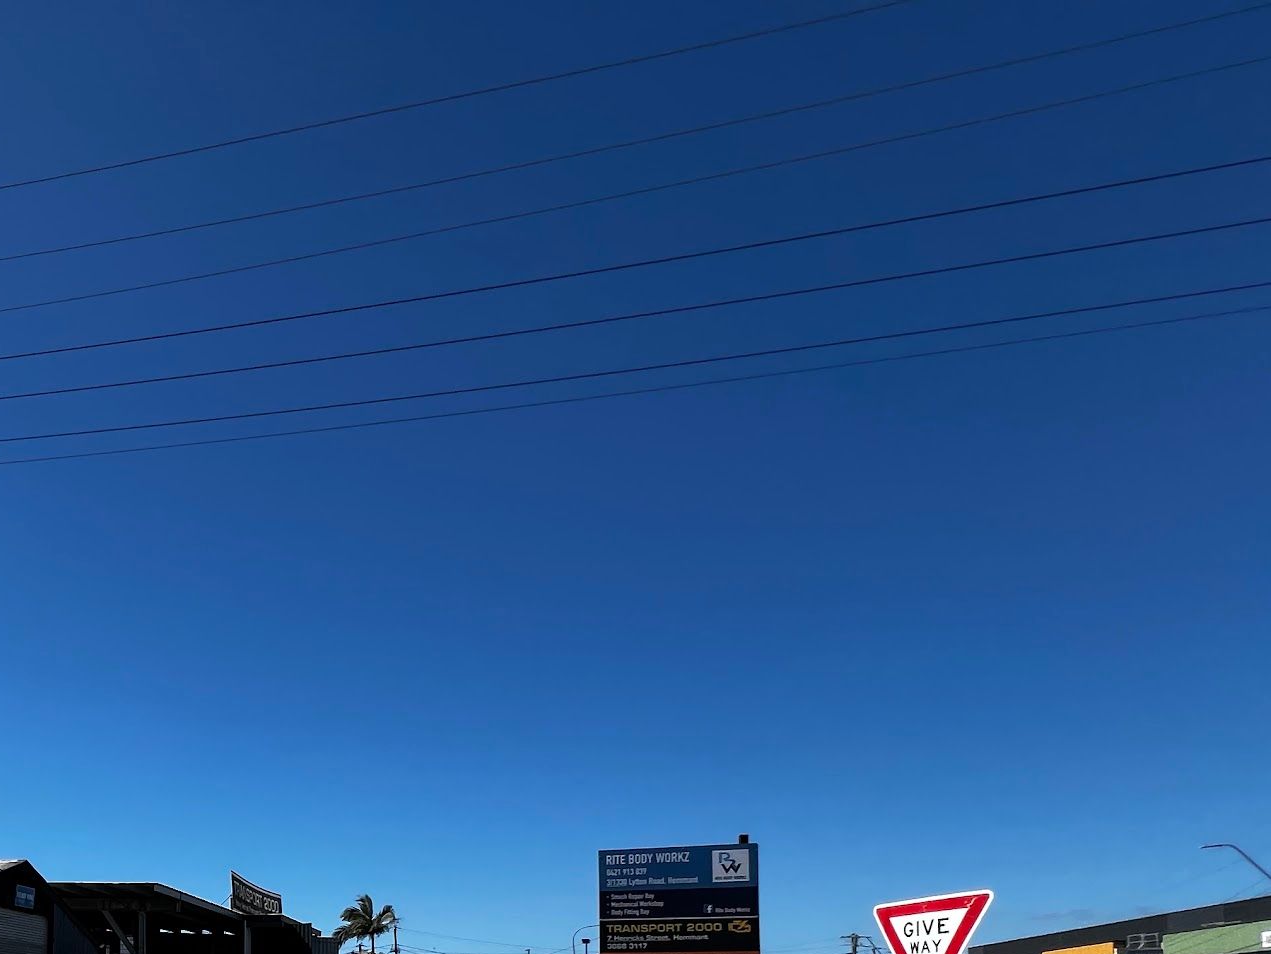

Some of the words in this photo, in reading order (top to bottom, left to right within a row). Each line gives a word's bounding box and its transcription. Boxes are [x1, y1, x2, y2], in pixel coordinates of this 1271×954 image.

[606, 854, 625, 866] RITE
[628, 853, 652, 865] BODY
[656, 851, 690, 863] WORKZ
[606, 923, 683, 933] TRANSPORT
[686, 922, 723, 932] 2000
[903, 917, 950, 937] GIVE
[910, 939, 942, 954] WAY
